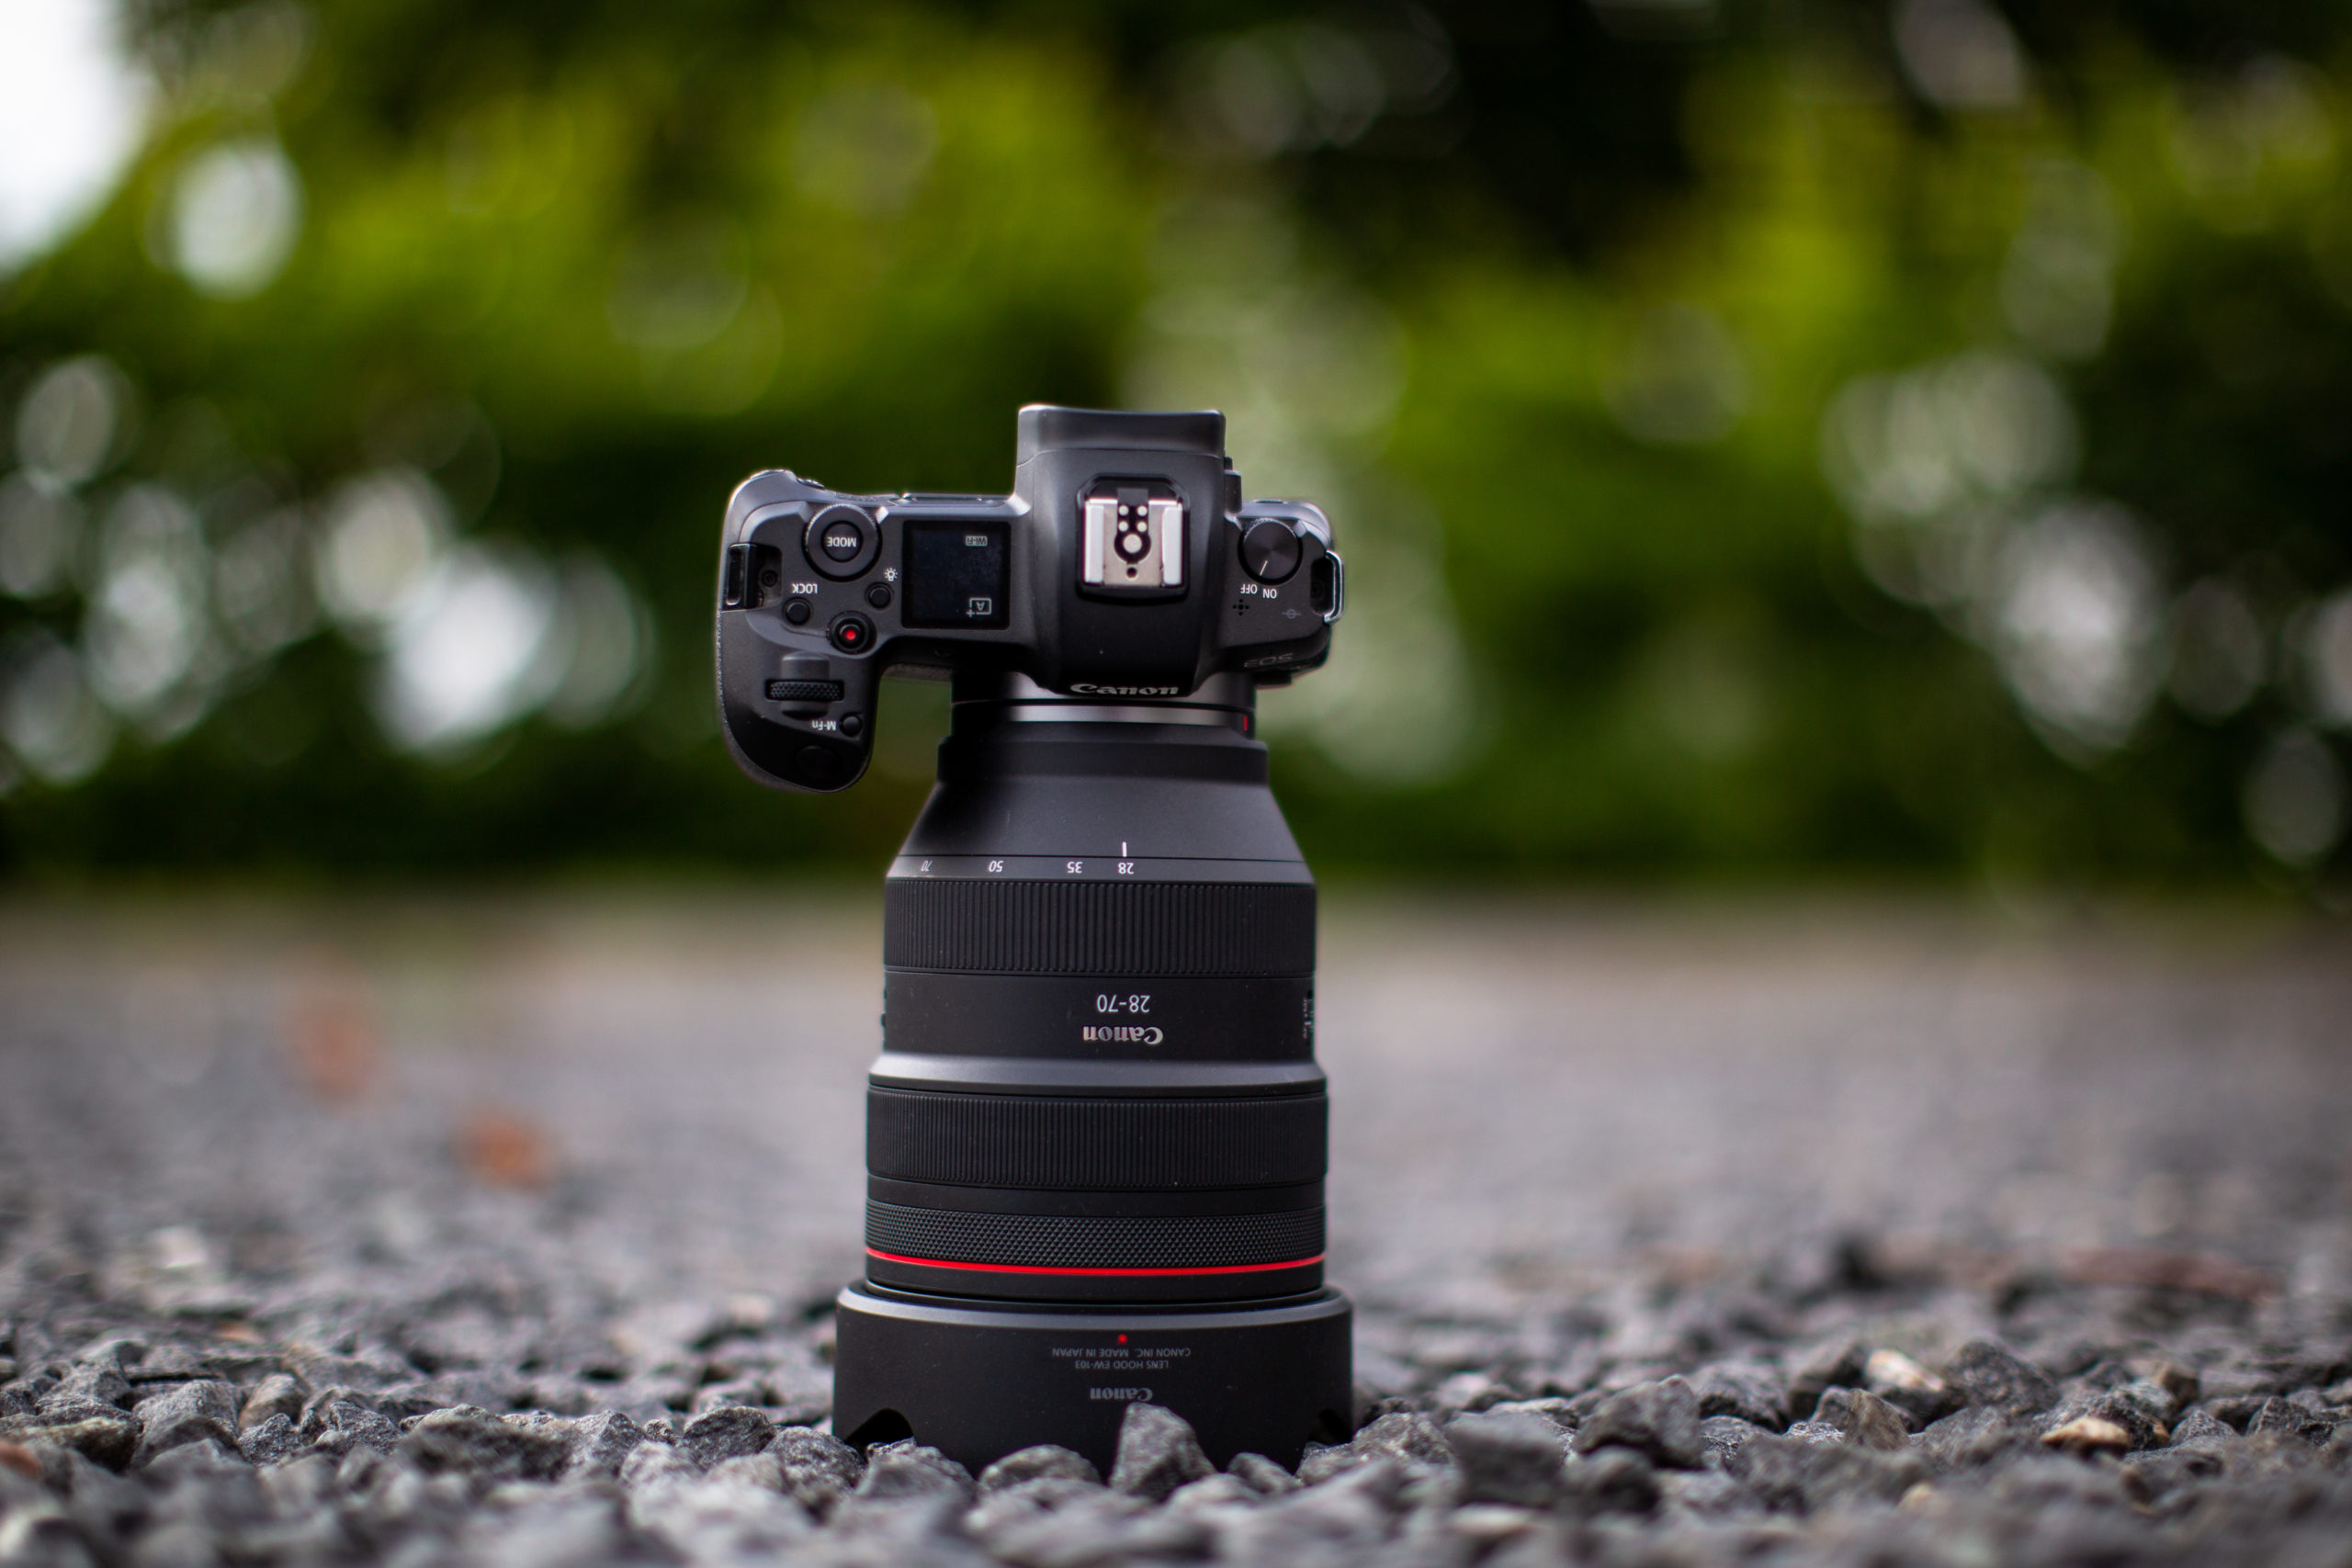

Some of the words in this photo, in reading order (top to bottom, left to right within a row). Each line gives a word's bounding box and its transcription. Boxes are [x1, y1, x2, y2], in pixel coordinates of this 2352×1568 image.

[827, 536, 857, 547] MODE
[791, 583, 818, 594] LOCK
[1240, 583, 1258, 594] OFF
[1262, 588, 1277, 599] ON
[1243, 652, 1294, 668] EOS
[1069, 683, 1179, 695] Canon
[811, 720, 837, 731] M-Fn
[989, 860, 1004, 873] 50
[1067, 861, 1083, 874] 35
[1117, 862, 1135, 874] 28
[1096, 994, 1150, 1013] 28-70
[1082, 1026, 1163, 1045] Canon
[1052, 1348, 1083, 1357] JAPAN
[1085, 1348, 1096, 1357] IN
[1099, 1348, 1129, 1357] MADE
[1156, 1348, 1191, 1357] CANON
[1074, 1359, 1110, 1369] EW-103
[1113, 1359, 1143, 1370] HOOD
[1146, 1359, 1169, 1369] LENS
[1090, 1387, 1153, 1402] Canon
